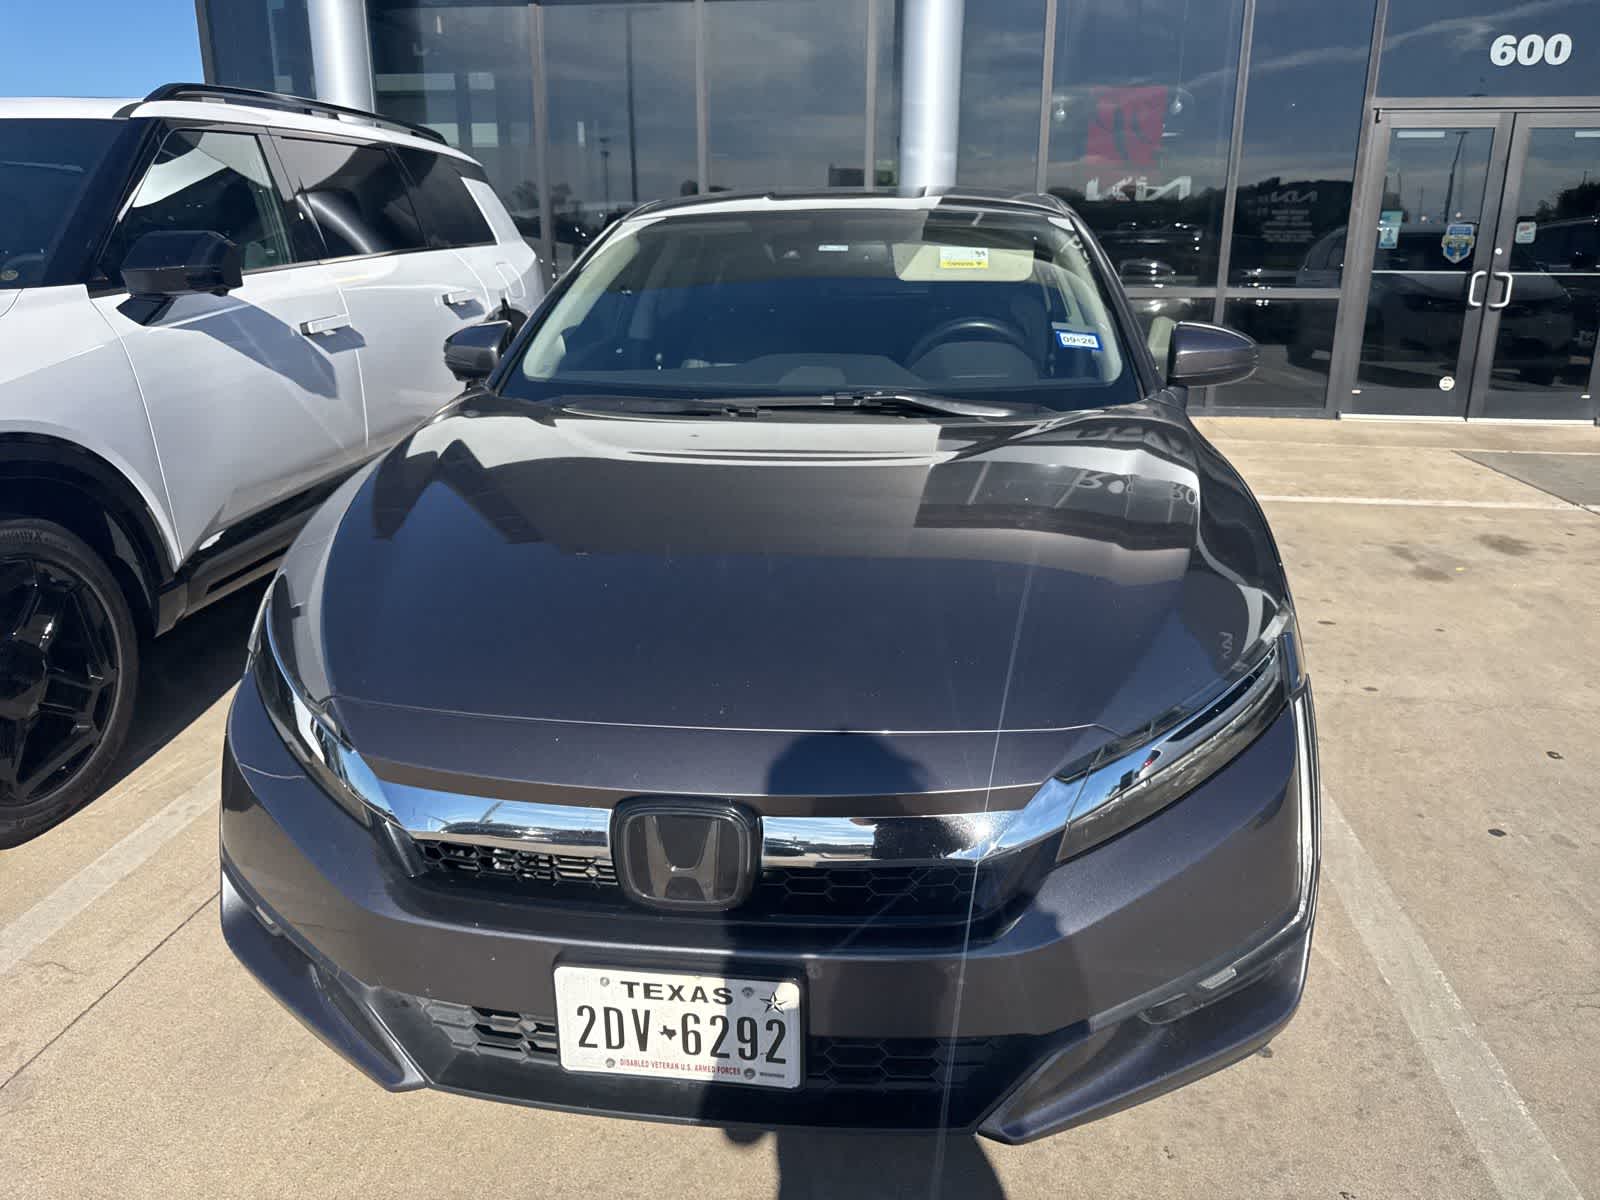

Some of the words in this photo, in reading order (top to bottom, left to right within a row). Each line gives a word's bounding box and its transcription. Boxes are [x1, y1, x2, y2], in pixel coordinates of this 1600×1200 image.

[1490, 33, 1572, 66] 600
[620, 980, 734, 1006] TEXAS
[576, 1005, 651, 1052] 2DV
[680, 1012, 787, 1065] 6292
[619, 1058, 650, 1068] DISABLED
[651, 1061, 679, 1070] VETERAN
[680, 1063, 692, 1072] U.S.
[694, 1064, 716, 1073] ARMED
[717, 1066, 741, 1076] FORCES
